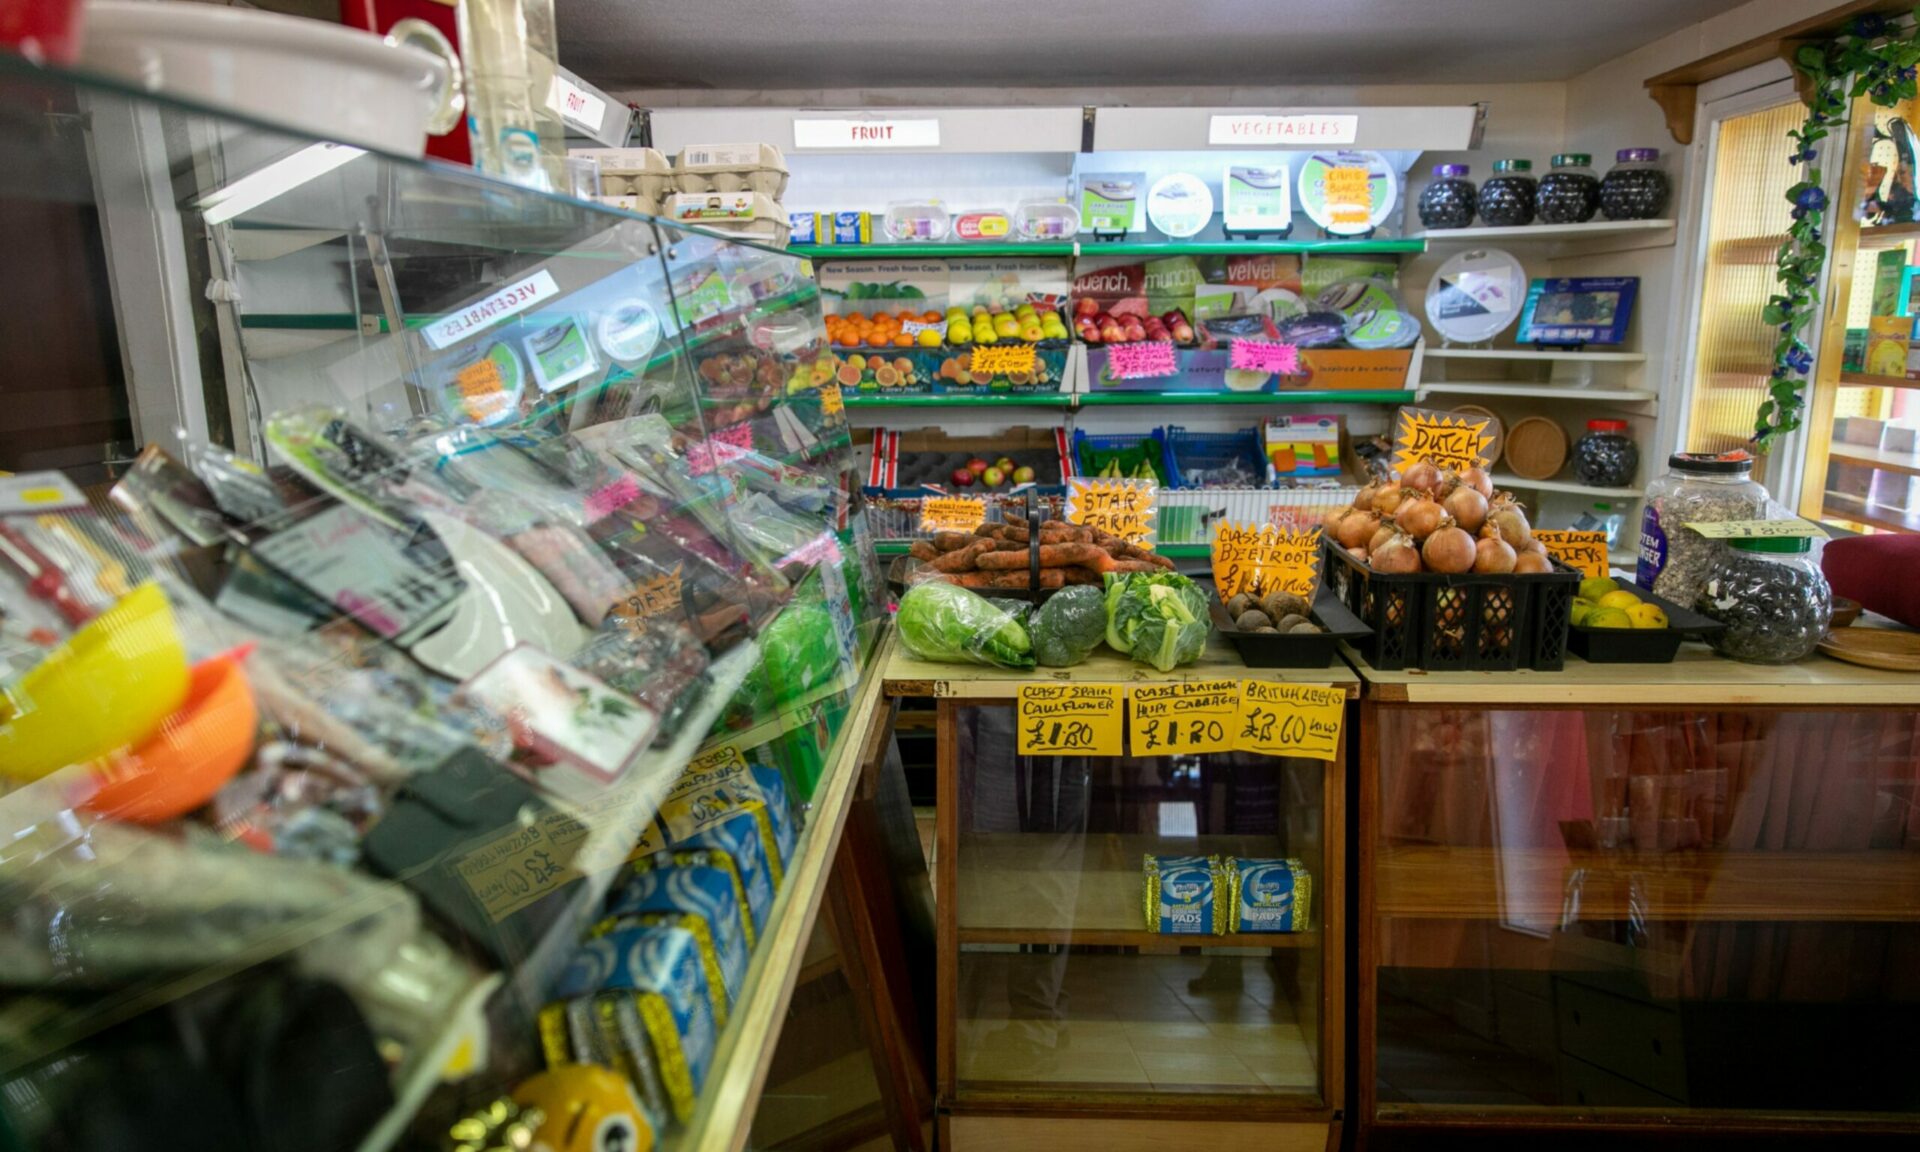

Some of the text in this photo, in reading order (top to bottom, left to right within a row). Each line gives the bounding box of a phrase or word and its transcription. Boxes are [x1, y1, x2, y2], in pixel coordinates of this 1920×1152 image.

[567, 92, 585, 113] FRUIT
[851, 126, 893, 139] FRUIT
[1231, 121, 1341, 136] VEGETABLES
[878, 264, 900, 272] Fresh
[902, 264, 919, 272] from
[1227, 259, 1281, 281] velvet.
[1072, 271, 1132, 293] quench.
[1411, 428, 1481, 455] DUTCH
[1084, 491, 1137, 512] STAR
[1082, 513, 1138, 531] FARM
[1220, 528, 1260, 545] CLASS
[1219, 543, 1315, 564] BEETROOT
[1071, 686, 1112, 697] SPAIN
[1246, 682, 1301, 700] BRITISH
[1171, 913, 1202, 923] PADS
[1252, 911, 1282, 921] PADS
